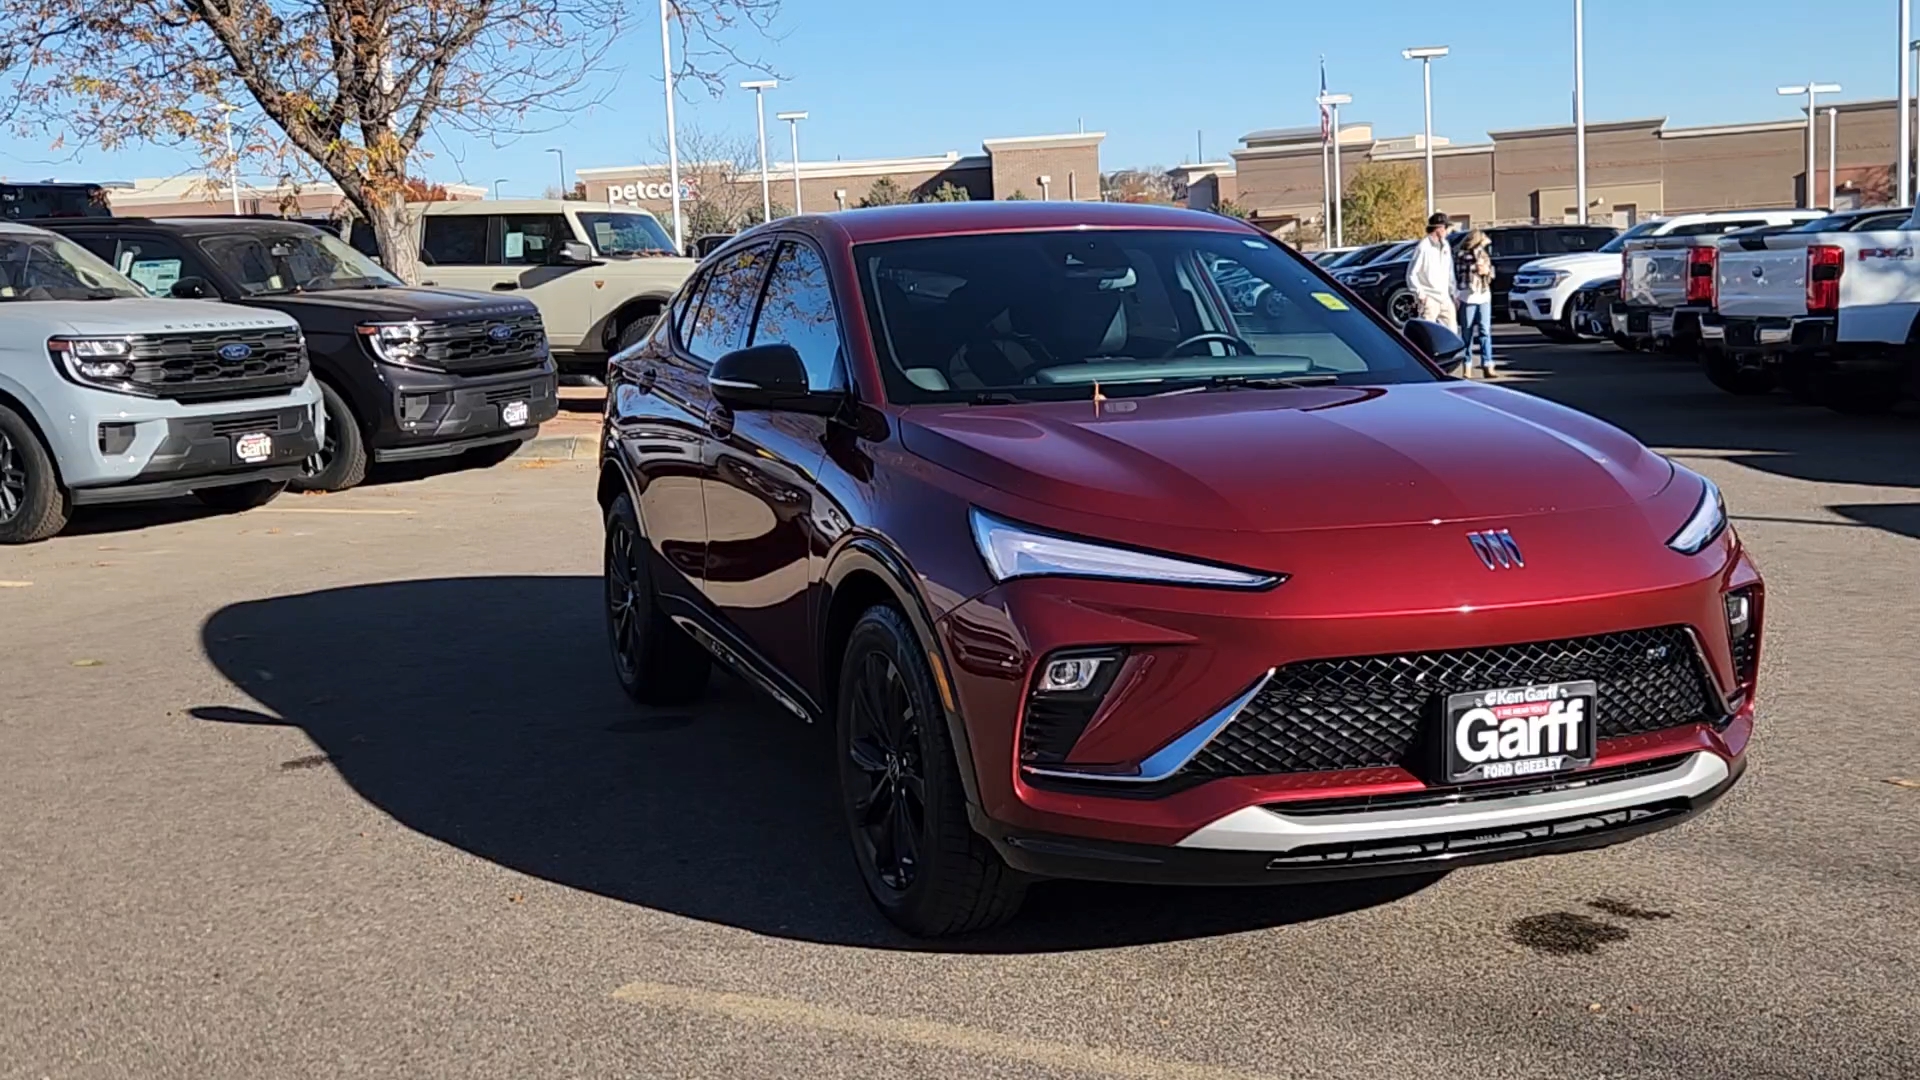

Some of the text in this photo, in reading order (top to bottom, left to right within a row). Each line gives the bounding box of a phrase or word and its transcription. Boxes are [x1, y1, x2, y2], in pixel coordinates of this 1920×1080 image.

[607, 180, 673, 205] petco
[236, 437, 271, 459] Garff
[1497, 684, 1559, 705] Ken Garff
[1456, 698, 1584, 763] Garff
[1483, 757, 1562, 778] FORD GREELEY
